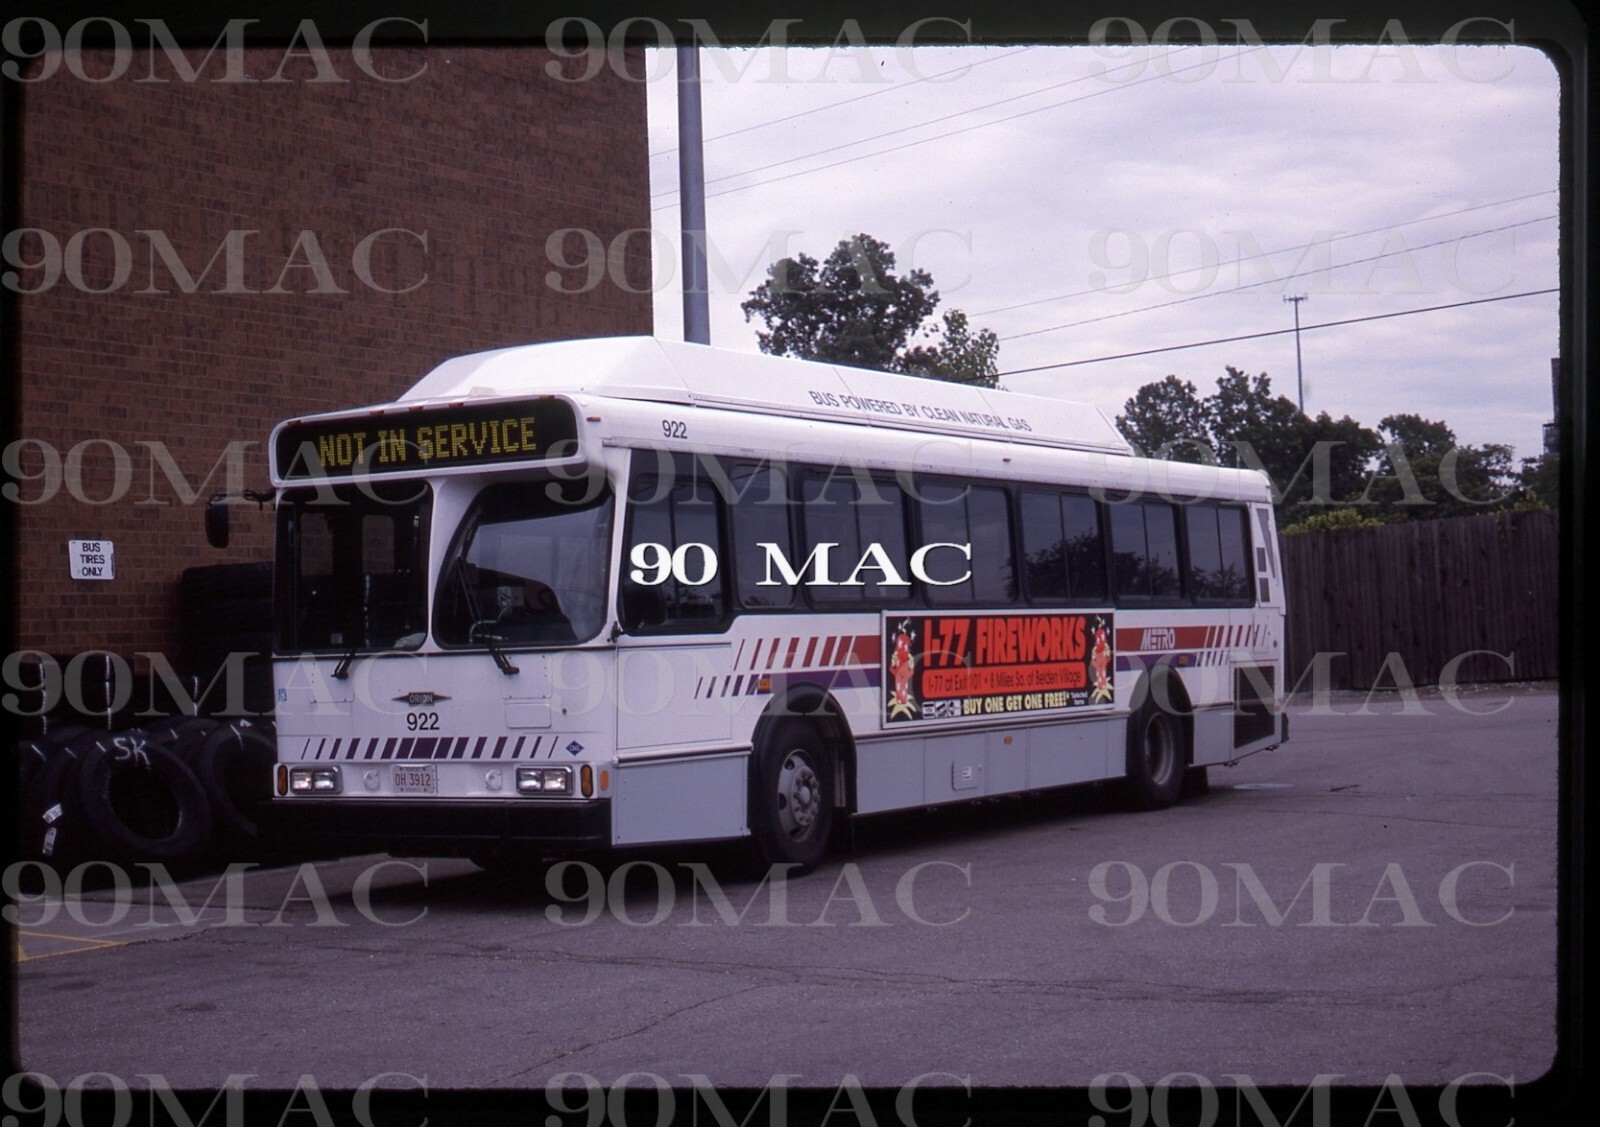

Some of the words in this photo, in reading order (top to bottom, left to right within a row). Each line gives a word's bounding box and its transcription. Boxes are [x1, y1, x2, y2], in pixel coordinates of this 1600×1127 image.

[809, 391, 840, 407] BUS
[840, 395, 901, 415] POWERED
[902, 404, 918, 417] BY
[922, 406, 959, 422] CLEAN
[961, 412, 1008, 429] NATURAL
[1011, 418, 1032, 432] GAS
[662, 419, 688, 439] 922
[319, 432, 366, 467] NOT
[378, 429, 406, 462] IN
[417, 417, 536, 460] SERVICE
[82, 542, 101, 552] BUS
[80, 554, 105, 565] TIRES
[81, 566, 103, 577] ONLY
[923, 618, 971, 667] I-77
[975, 616, 1086, 664] FIREWORKS
[1140, 628, 1176, 650] METRO
[927, 675, 943, 693] I-77
[954, 674, 967, 691] Exit
[969, 673, 982, 690] 101
[996, 672, 1014, 688] Miles
[1027, 671, 1036, 687] of
[1035, 670, 1058, 686] Belden
[1059, 668, 1081, 688] Village
[409, 694, 433, 703] ORION
[963, 698, 982, 715] BUY
[985, 696, 1004, 713] ONE
[1005, 695, 1023, 711] GET
[1024, 693, 1043, 709] ONE
[406, 712, 440, 731] 922
[410, 773, 431, 786] 3912
